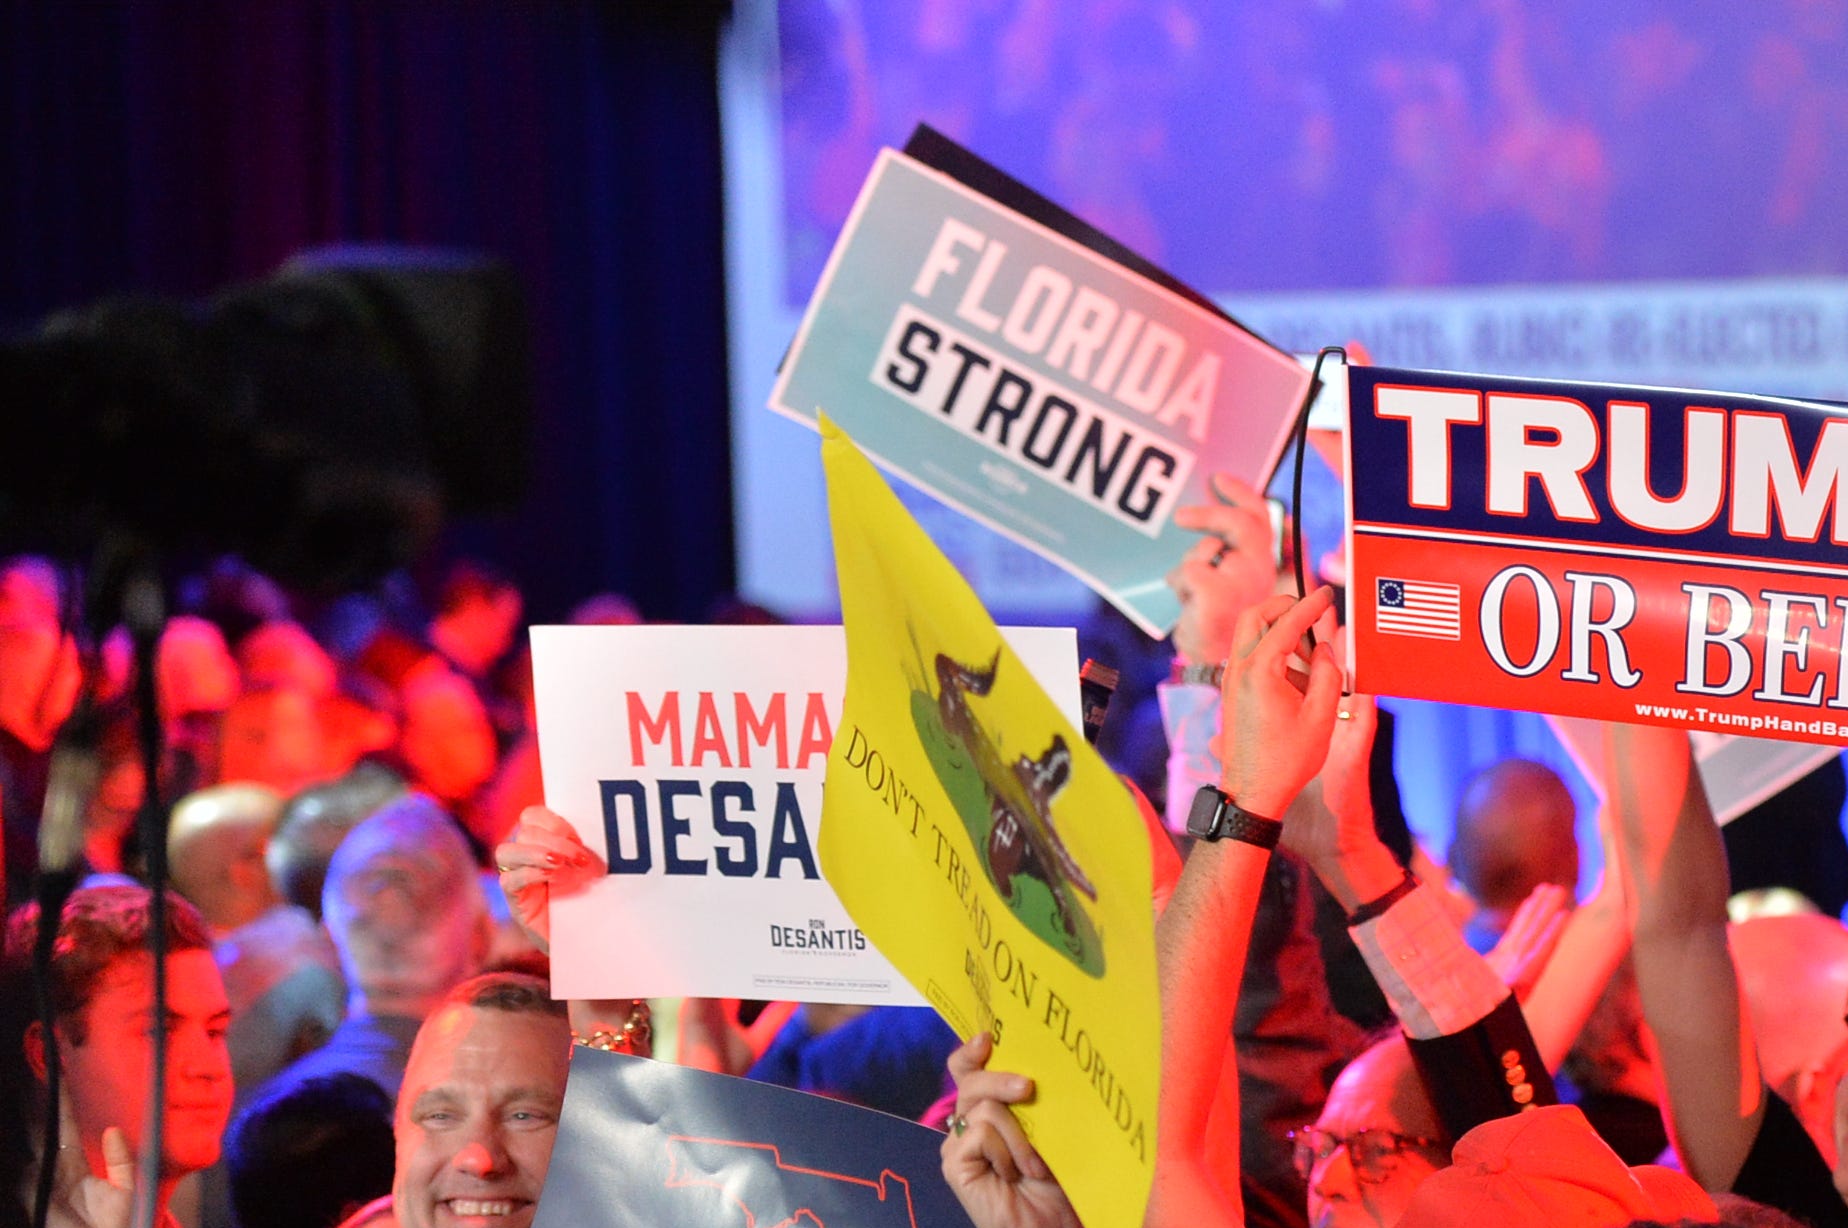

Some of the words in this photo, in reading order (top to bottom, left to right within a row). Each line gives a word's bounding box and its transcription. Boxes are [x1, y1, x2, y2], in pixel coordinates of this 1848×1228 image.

[912, 217, 1225, 443] FLORIDA
[887, 320, 1178, 525] STRONG
[1479, 564, 1643, 689] OR
[625, 691, 846, 769] MAMA
[598, 780, 826, 880] DESA
[771, 925, 866, 950] DESANTIS
[842, 724, 926, 840] DON'T
[931, 823, 991, 950] TREAD
[993, 940, 1039, 1009] ON
[1043, 989, 1147, 1167] FLORIDA
